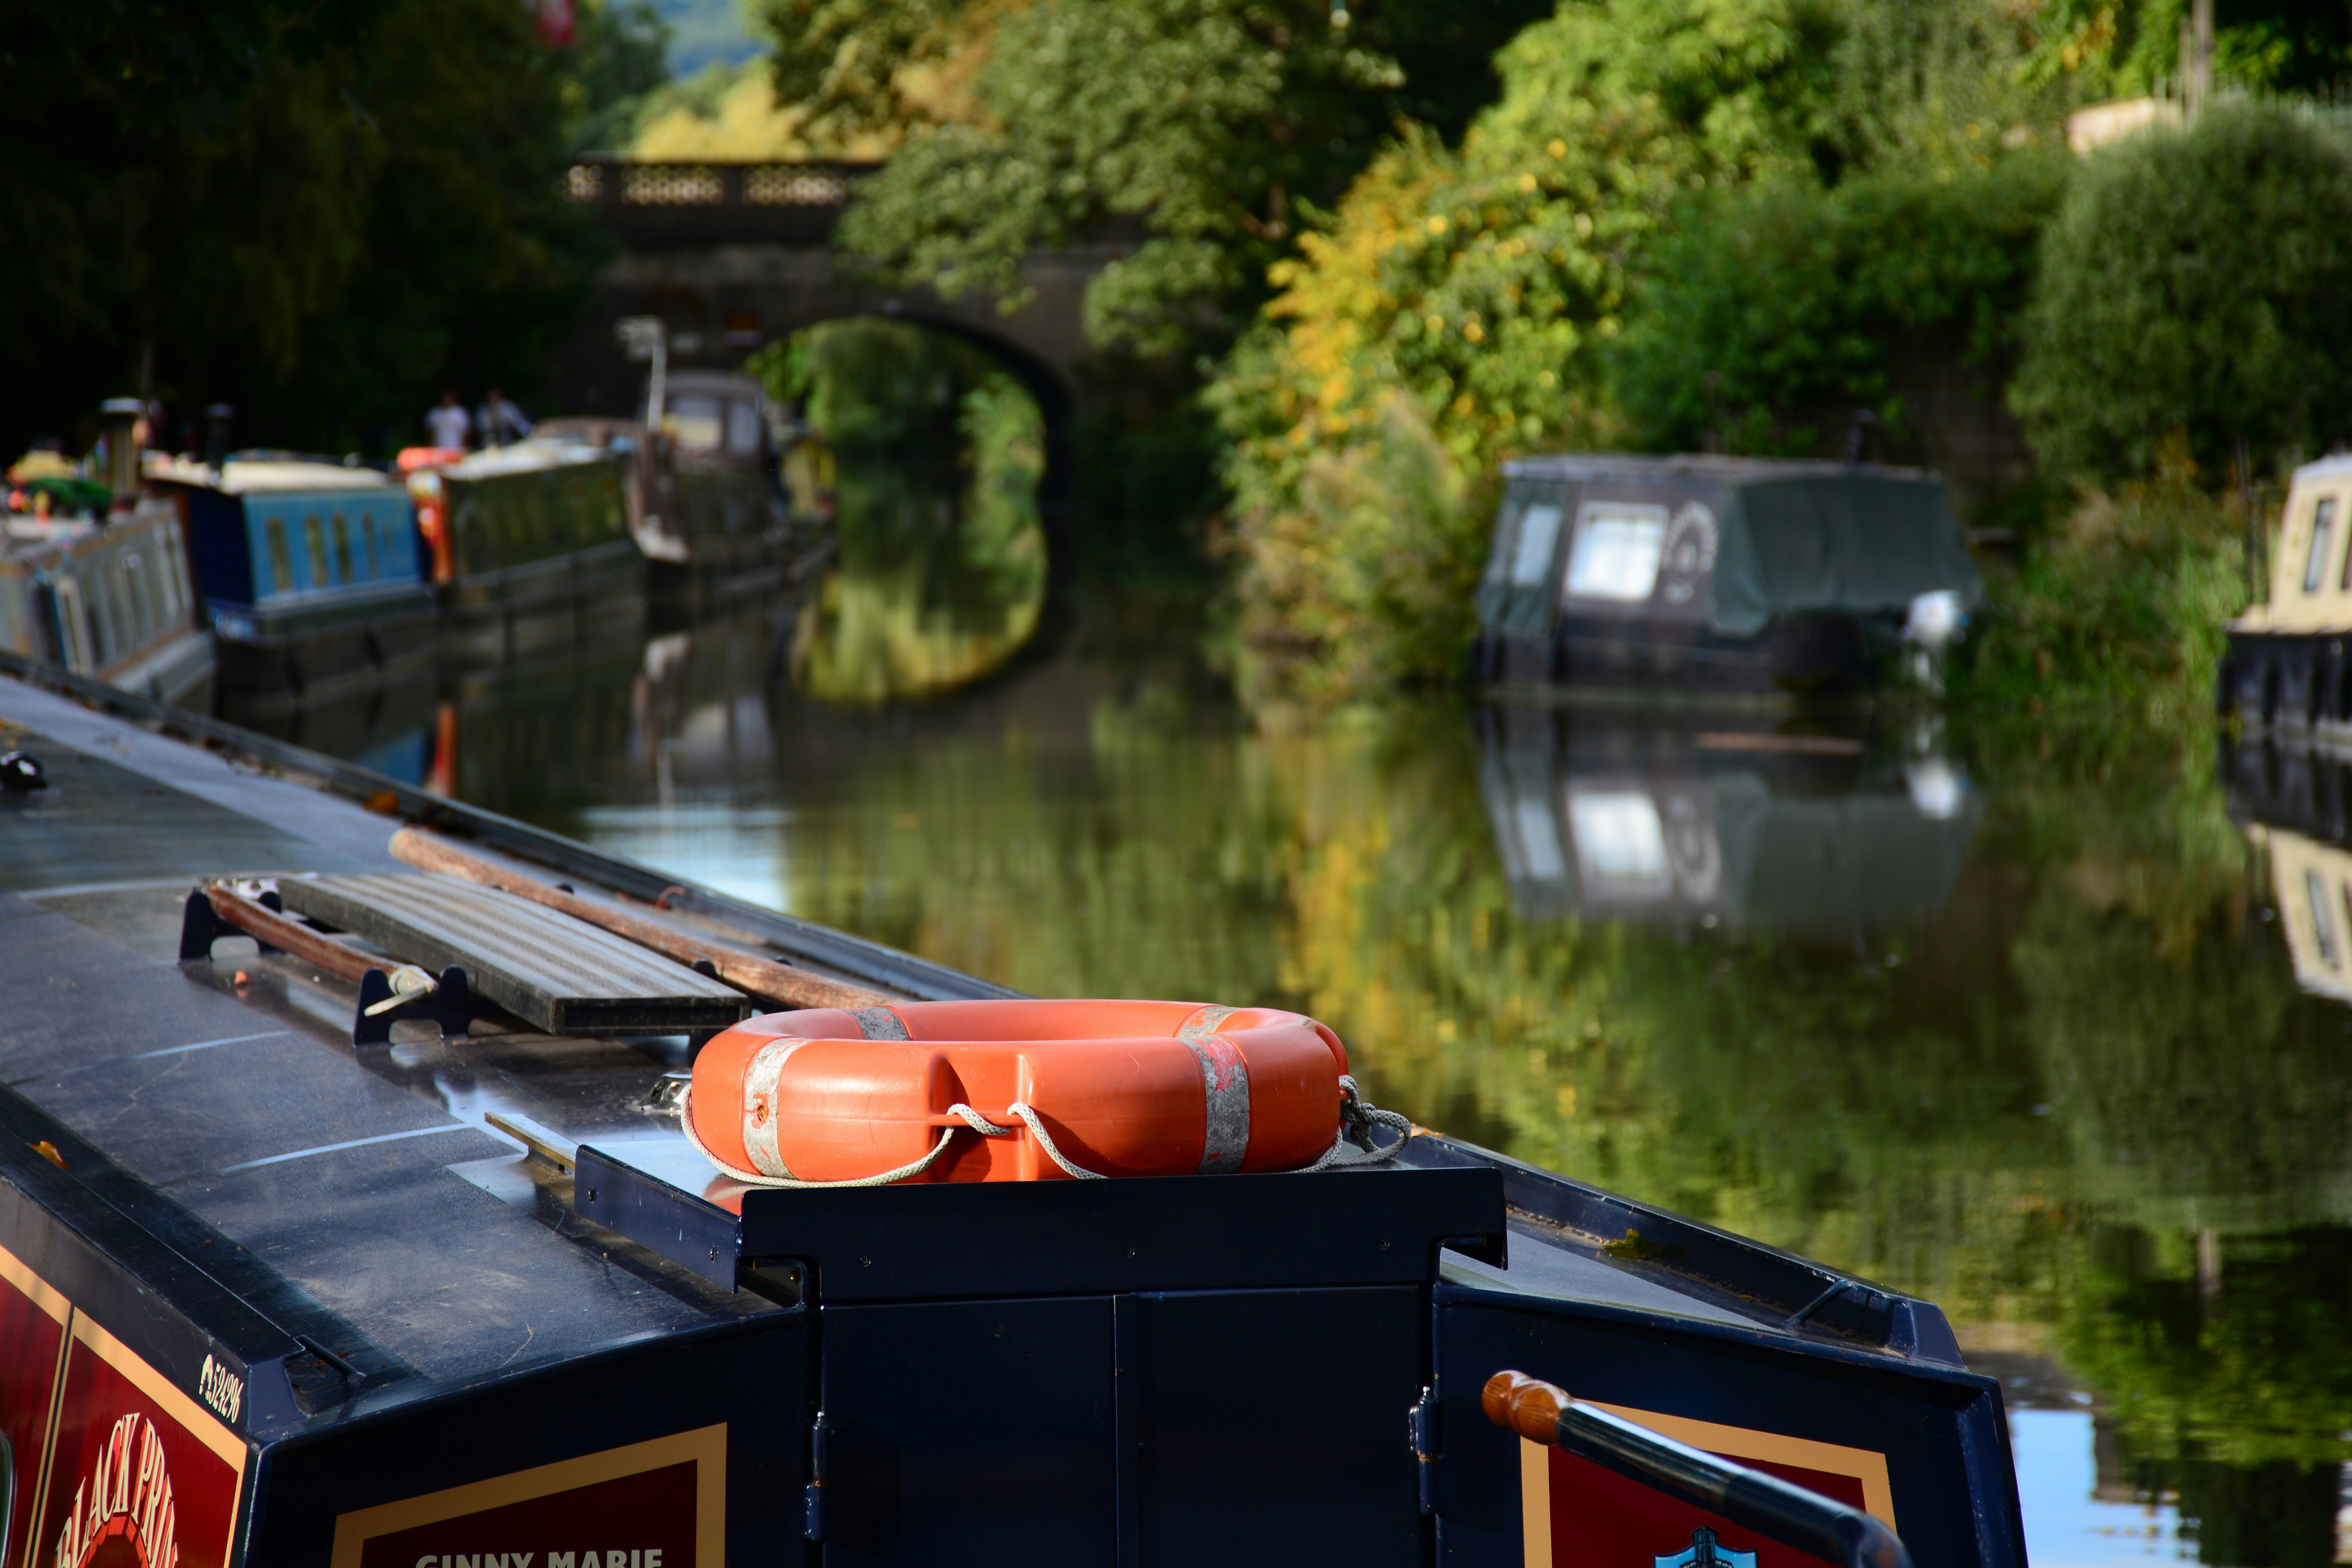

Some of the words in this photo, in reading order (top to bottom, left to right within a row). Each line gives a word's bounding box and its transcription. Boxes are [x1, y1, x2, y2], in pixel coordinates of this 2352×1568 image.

[208, 1362, 244, 1423] 524296
[56, 1412, 140, 1568] BLACK
[548, 1549, 662, 1568] MARIE
